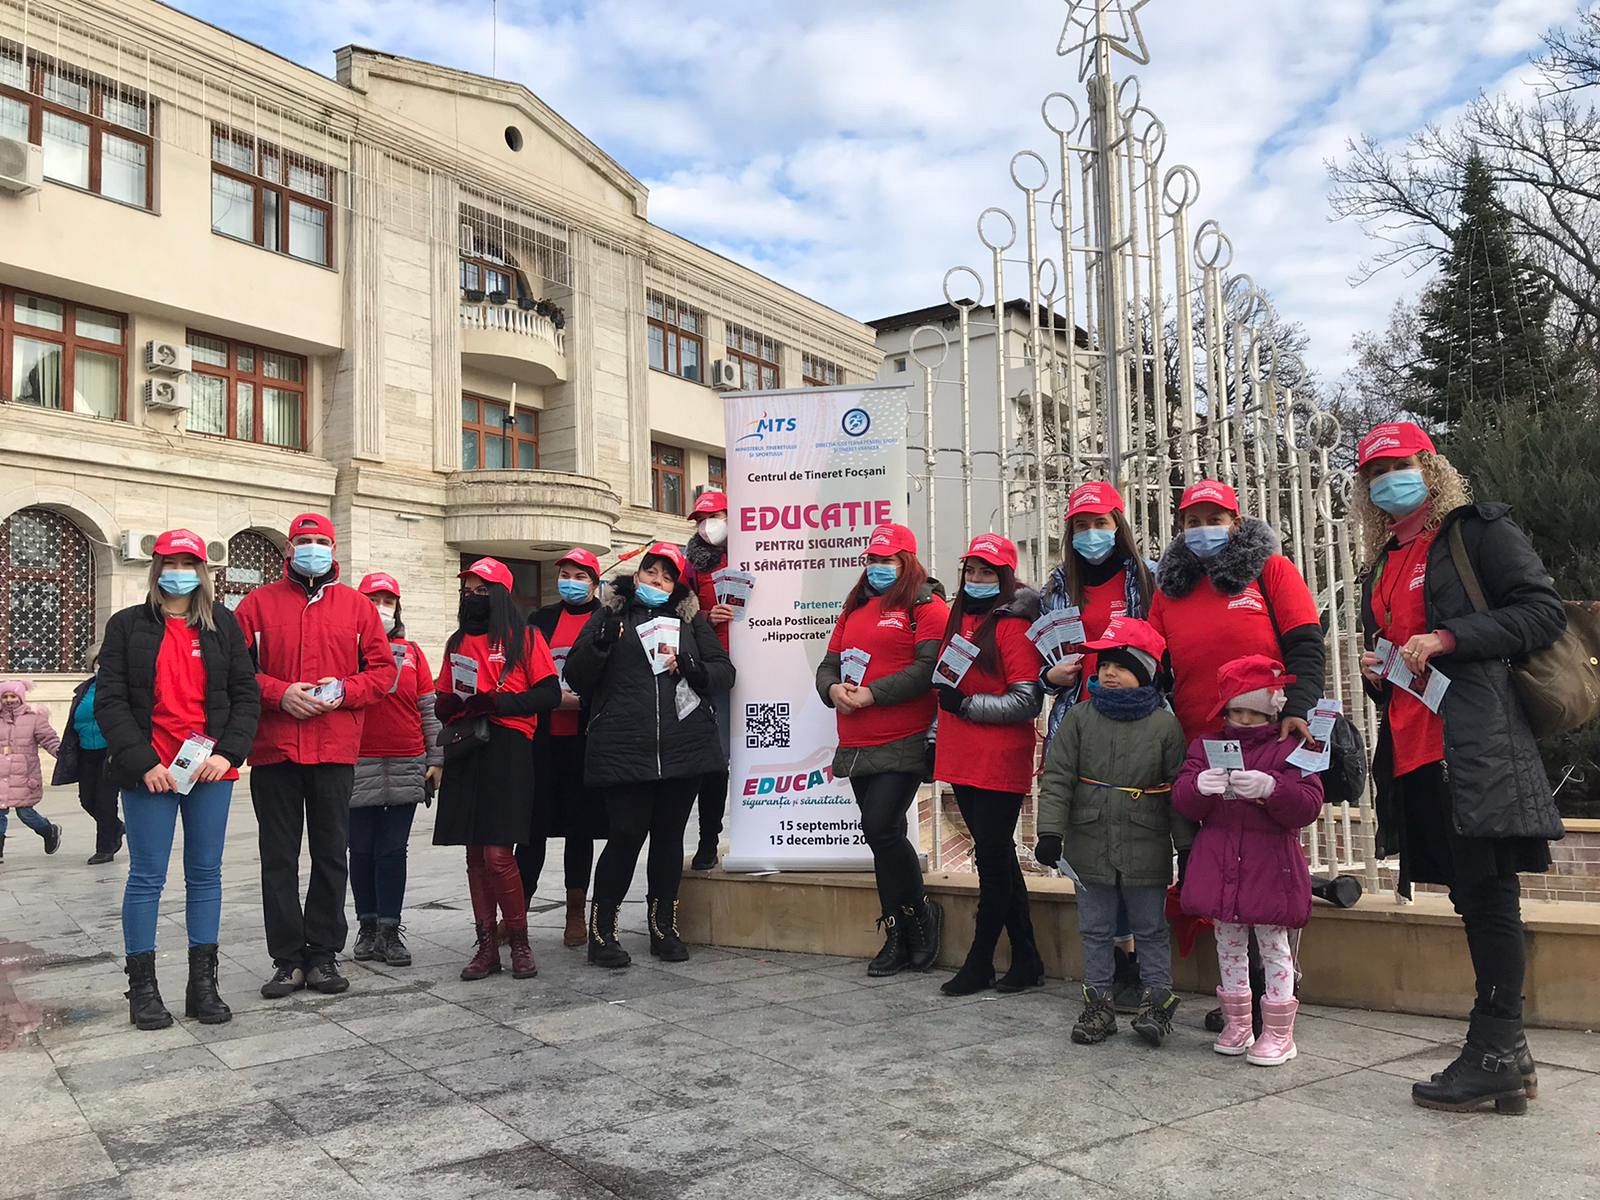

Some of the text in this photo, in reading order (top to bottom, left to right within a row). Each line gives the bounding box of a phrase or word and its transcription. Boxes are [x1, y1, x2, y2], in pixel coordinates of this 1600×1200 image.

[748, 471, 787, 482] Centrul
[789, 471, 803, 480] de
[805, 469, 842, 479] Tineret
[740, 500, 893, 532] EDUCAȚIE
[755, 540, 803, 551] PENTRU
[808, 536, 871, 550] SIGURANȚ
[754, 558, 825, 571] SĂNĂTATEA
[830, 556, 868, 568] TINER
[794, 600, 842, 609] Partener:
[743, 764, 834, 796] EDUCAT
[780, 819, 863, 832] 15 septembrie
[770, 834, 867, 845] 15 decembrie 20
